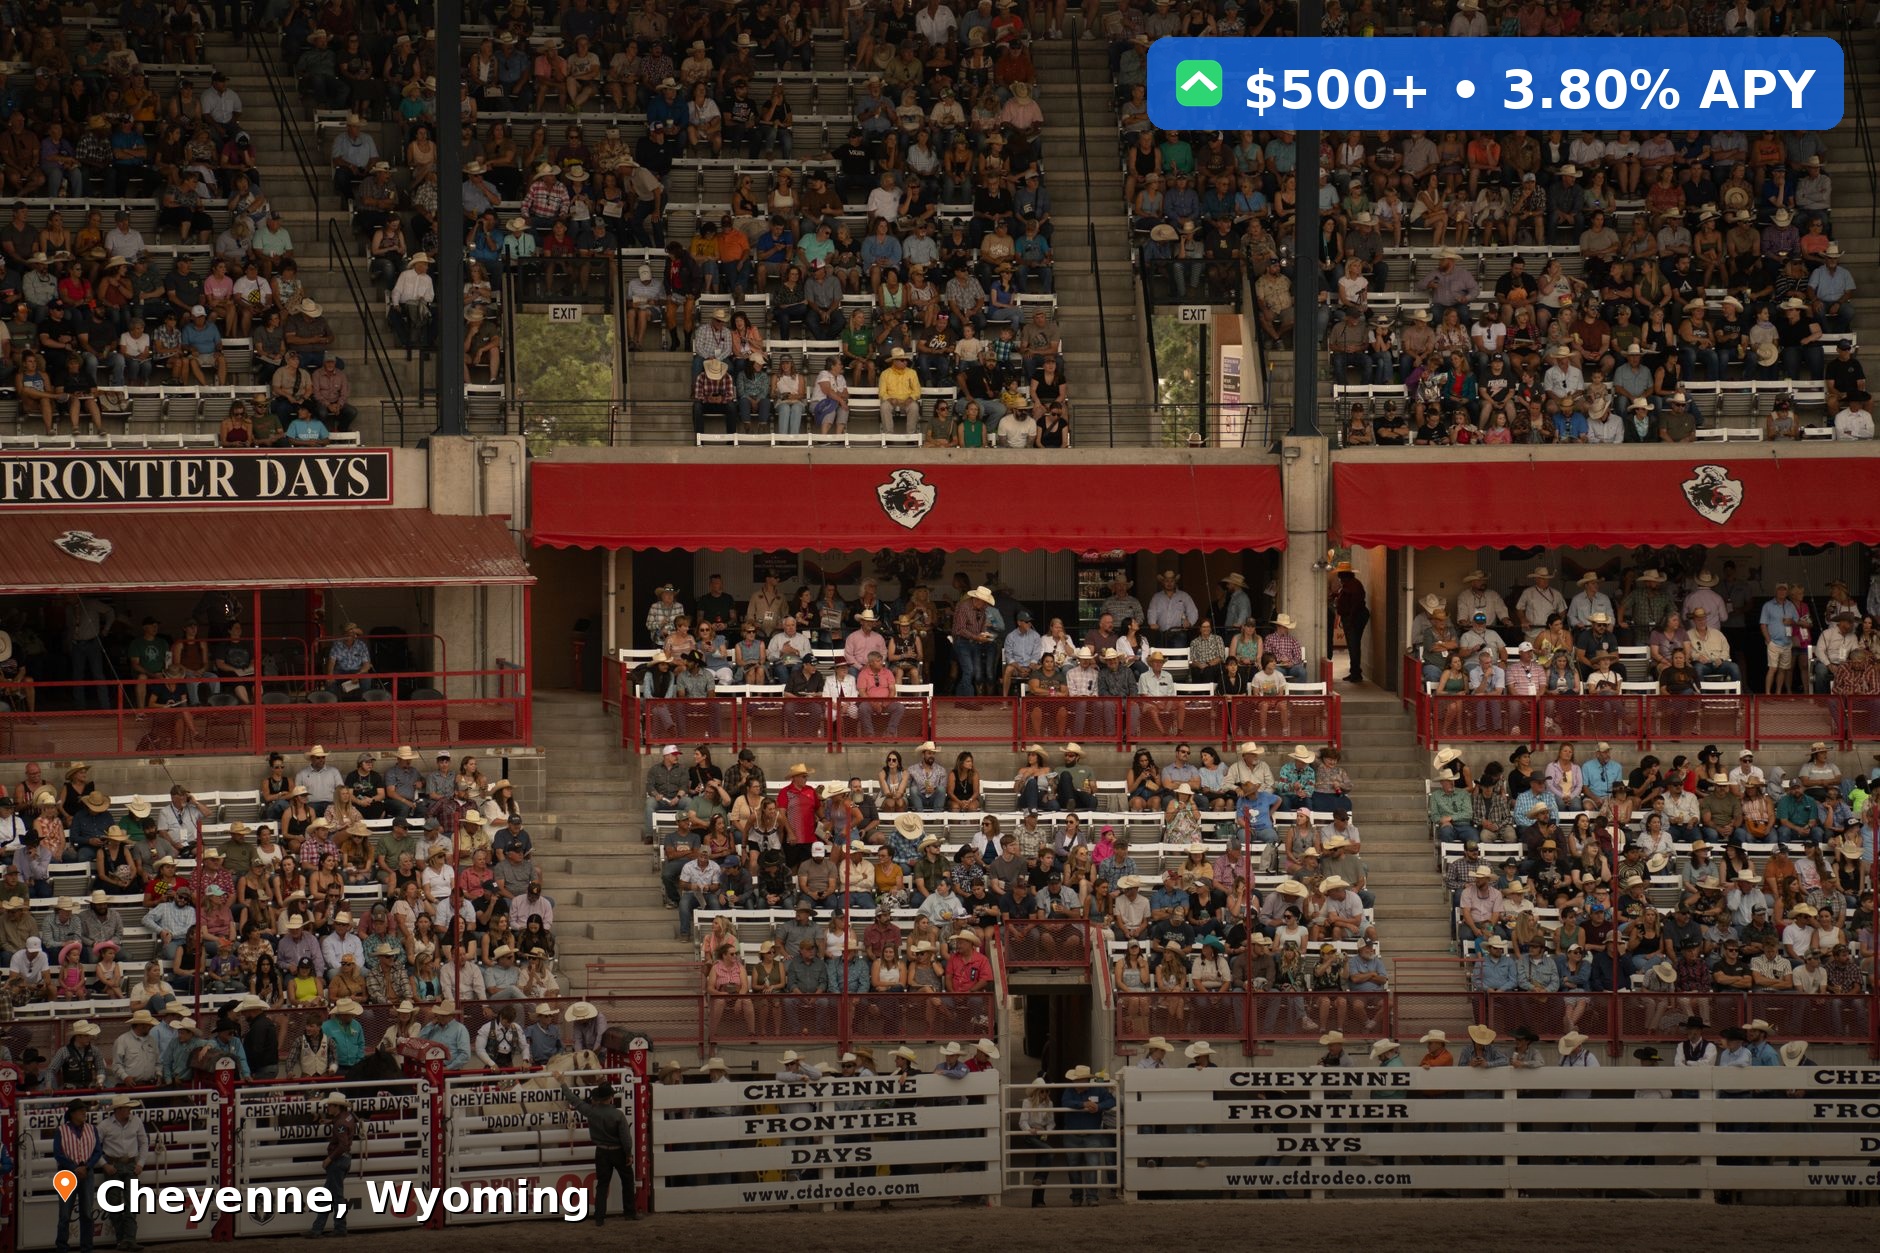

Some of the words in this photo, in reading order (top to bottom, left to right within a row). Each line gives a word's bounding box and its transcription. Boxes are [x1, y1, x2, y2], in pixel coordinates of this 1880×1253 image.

[552, 308, 577, 319] EXIT
[1182, 309, 1206, 320] EXIT
[1, 458, 238, 500] FRONTIER
[256, 457, 370, 497] DAYS
[1229, 1072, 1410, 1087] CHEYENNE
[1814, 1070, 1880, 1084] CHE
[451, 1092, 517, 1107] CHEYENNE
[520, 1087, 581, 1103] FRONTIR
[743, 1079, 917, 1100] CHEYENNE
[246, 1102, 312, 1118] CHEYENNE
[1228, 1104, 1409, 1119] FRONTIER
[1813, 1103, 1880, 1118] FRO
[530, 1112, 545, 1127] OF
[745, 1111, 918, 1135] FRONTIER
[1276, 1137, 1362, 1152] DAYS
[791, 1146, 873, 1165] DAYS
[1226, 1170, 1412, 1186] www.cfdrodeo.com
[743, 1182, 920, 1203] www.cfdrodeo.com
